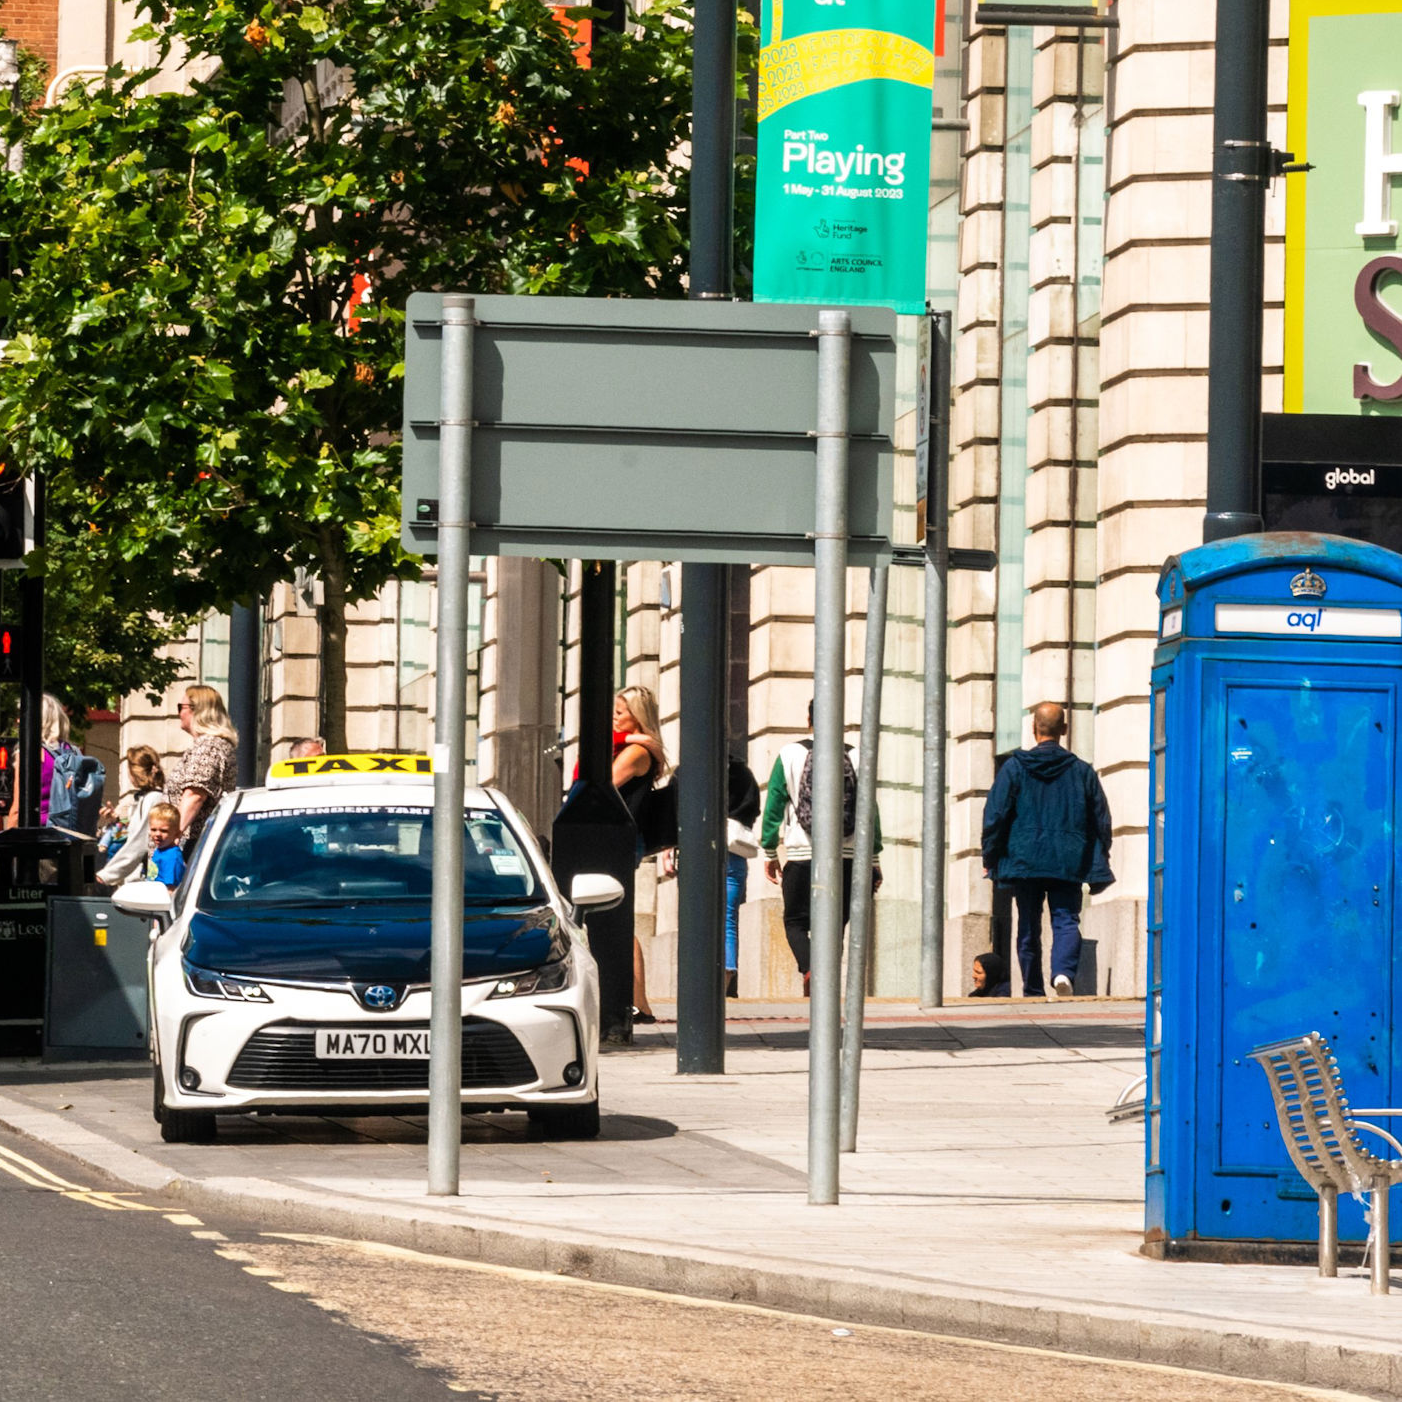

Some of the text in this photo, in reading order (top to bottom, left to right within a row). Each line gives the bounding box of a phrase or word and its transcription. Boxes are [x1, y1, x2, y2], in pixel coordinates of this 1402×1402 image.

[760, 43, 798, 68] 2023
[767, 61, 801, 88] 2023
[784, 128, 829, 141] Part Two
[782, 141, 906, 186] Playing
[782, 184, 788, 194] 1
[790, 184, 814, 198] May
[821, 184, 835, 196] 31
[836, 185, 872, 200] August
[874, 188, 904, 199] 2023
[832, 224, 868, 234] Heritage
[832, 232, 852, 240] Fund
[830, 258, 883, 266] ARTS COUNCIL
[830, 266, 866, 274] ENGLAND
[1324, 468, 1375, 490] global
[1286, 608, 1322, 632] aql
[284, 758, 433, 774] TAXI
[248, 806, 430, 820] INDEPENDENT TAXI
[8, 888, 44, 900] Litter
[18, 924, 46, 936] Lee
[326, 1033, 386, 1054] MA70
